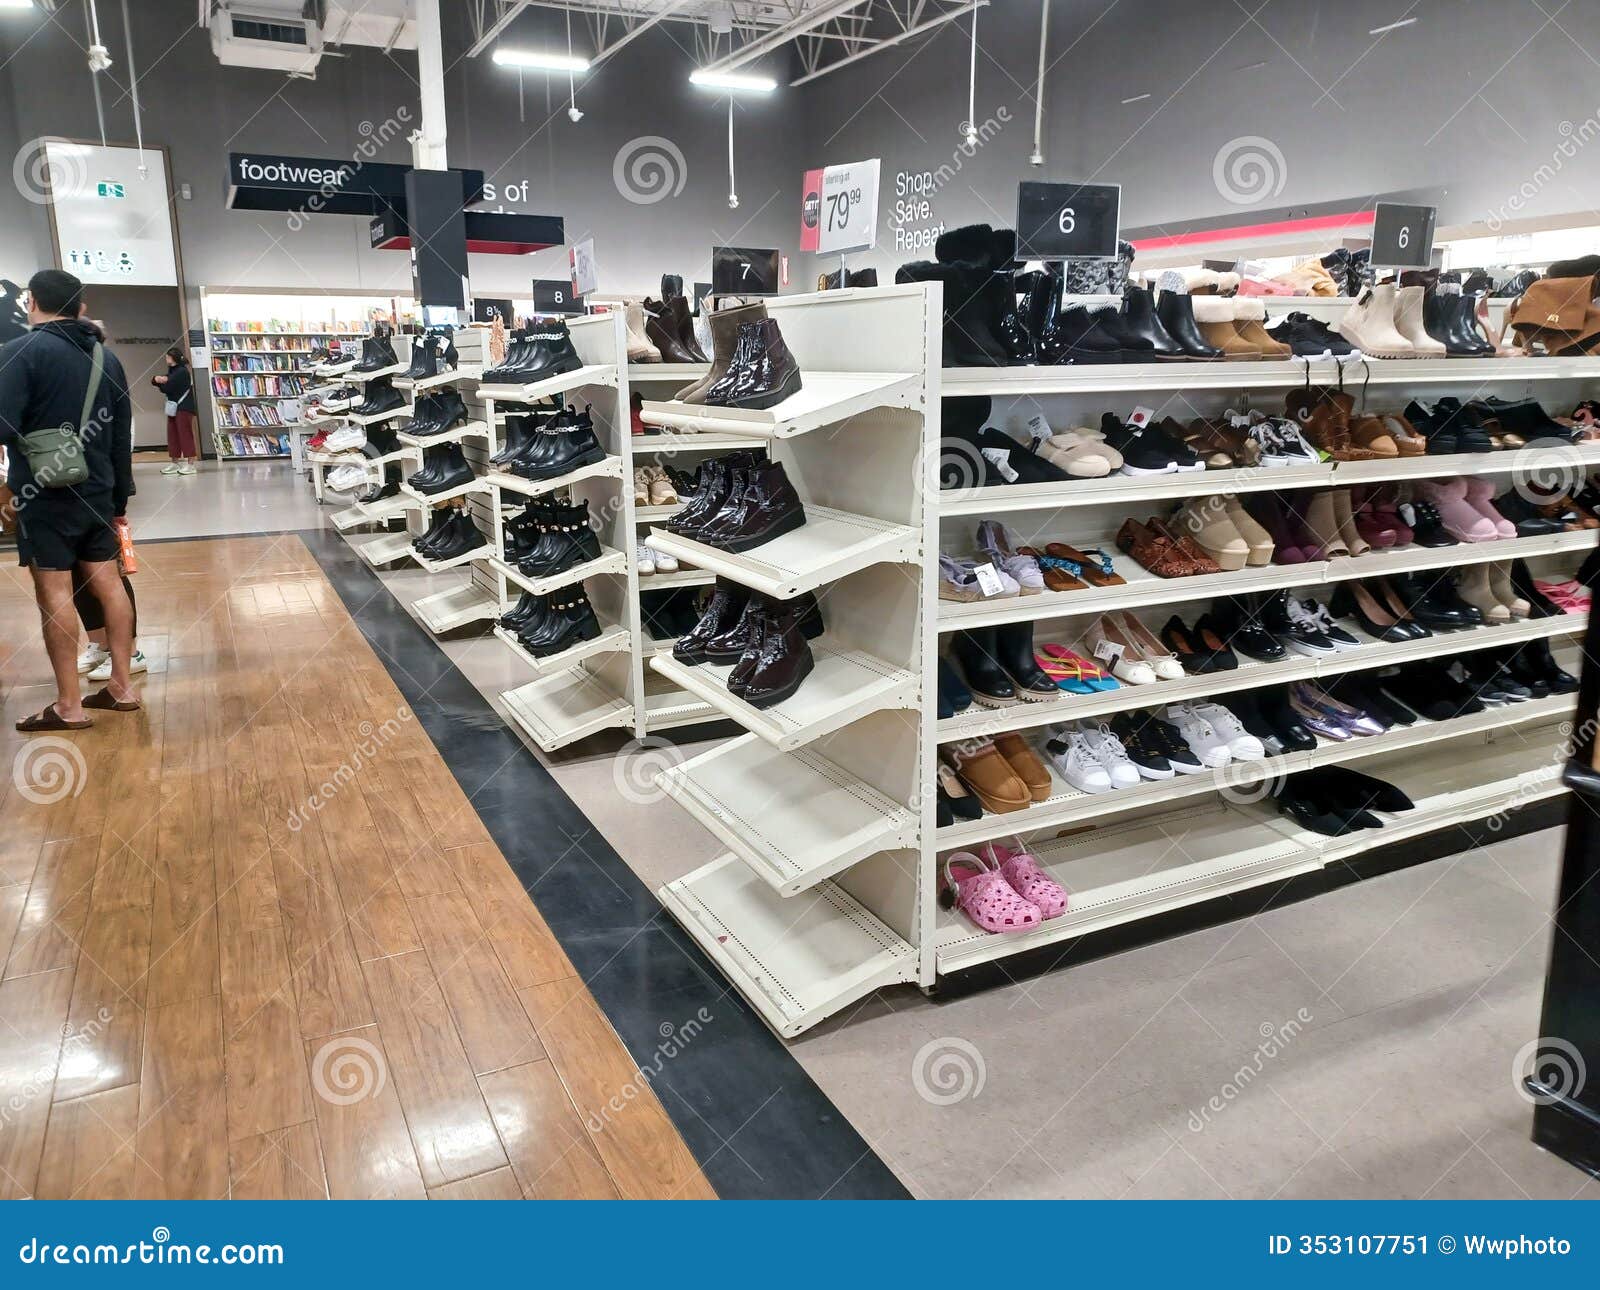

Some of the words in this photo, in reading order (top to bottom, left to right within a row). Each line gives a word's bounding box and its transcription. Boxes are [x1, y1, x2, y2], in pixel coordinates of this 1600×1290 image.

[239, 159, 346, 186] footwear
[896, 171, 936, 196] Shop.
[504, 180, 529, 202] of
[895, 200, 933, 224] Save.
[1059, 207, 1075, 234] 6
[1398, 226, 1410, 249] 6
[740, 263, 752, 280] 7
[554, 291, 563, 303] 8
